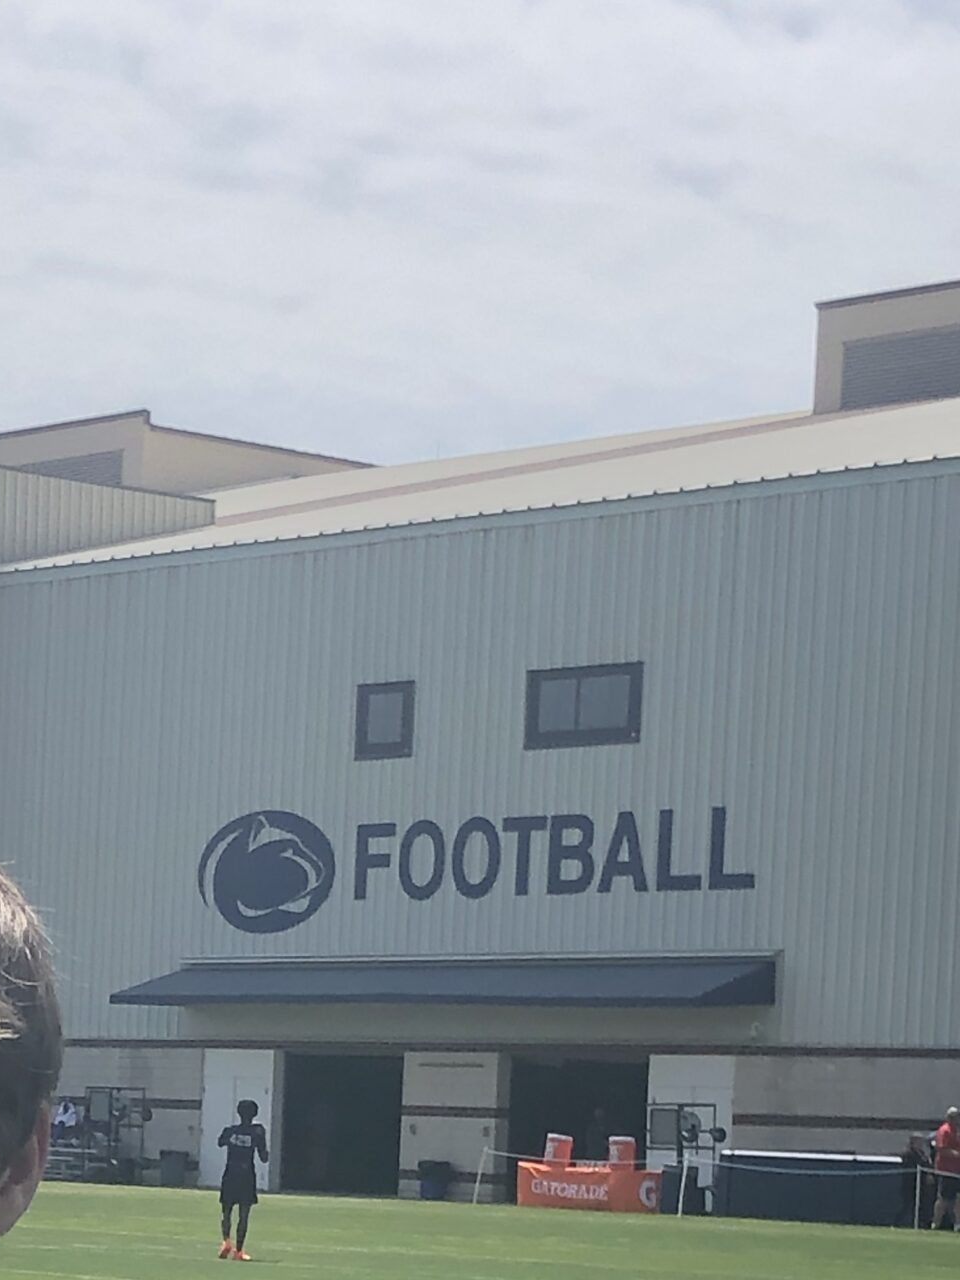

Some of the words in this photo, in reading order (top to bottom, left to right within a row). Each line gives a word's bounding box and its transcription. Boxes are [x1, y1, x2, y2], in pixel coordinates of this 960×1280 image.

[353, 806, 756, 900] FOOTBALL
[530, 1178, 609, 1201] GATORADE
[639, 1179, 657, 1208] G
